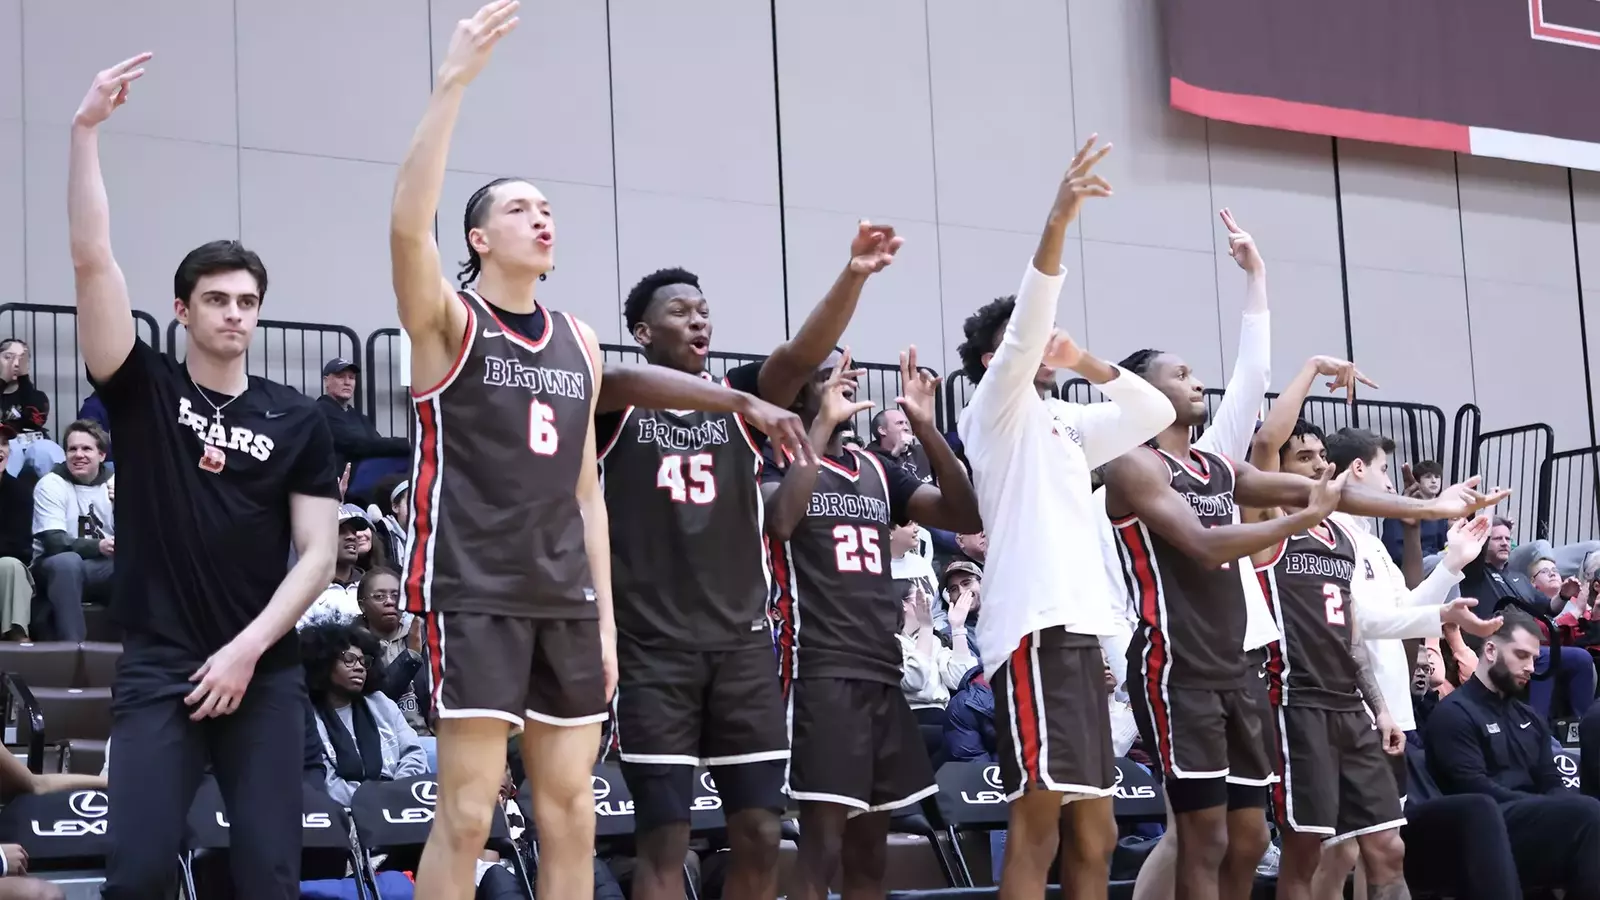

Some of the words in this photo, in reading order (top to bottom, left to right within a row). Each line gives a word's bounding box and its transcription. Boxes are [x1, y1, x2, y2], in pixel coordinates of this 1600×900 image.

[483, 355, 585, 400] BROWN
[528, 397, 559, 457] 6
[637, 417, 730, 451] BROWN
[656, 453, 717, 505] 45
[832, 524, 884, 575] 25
[1322, 582, 1347, 627] 2
